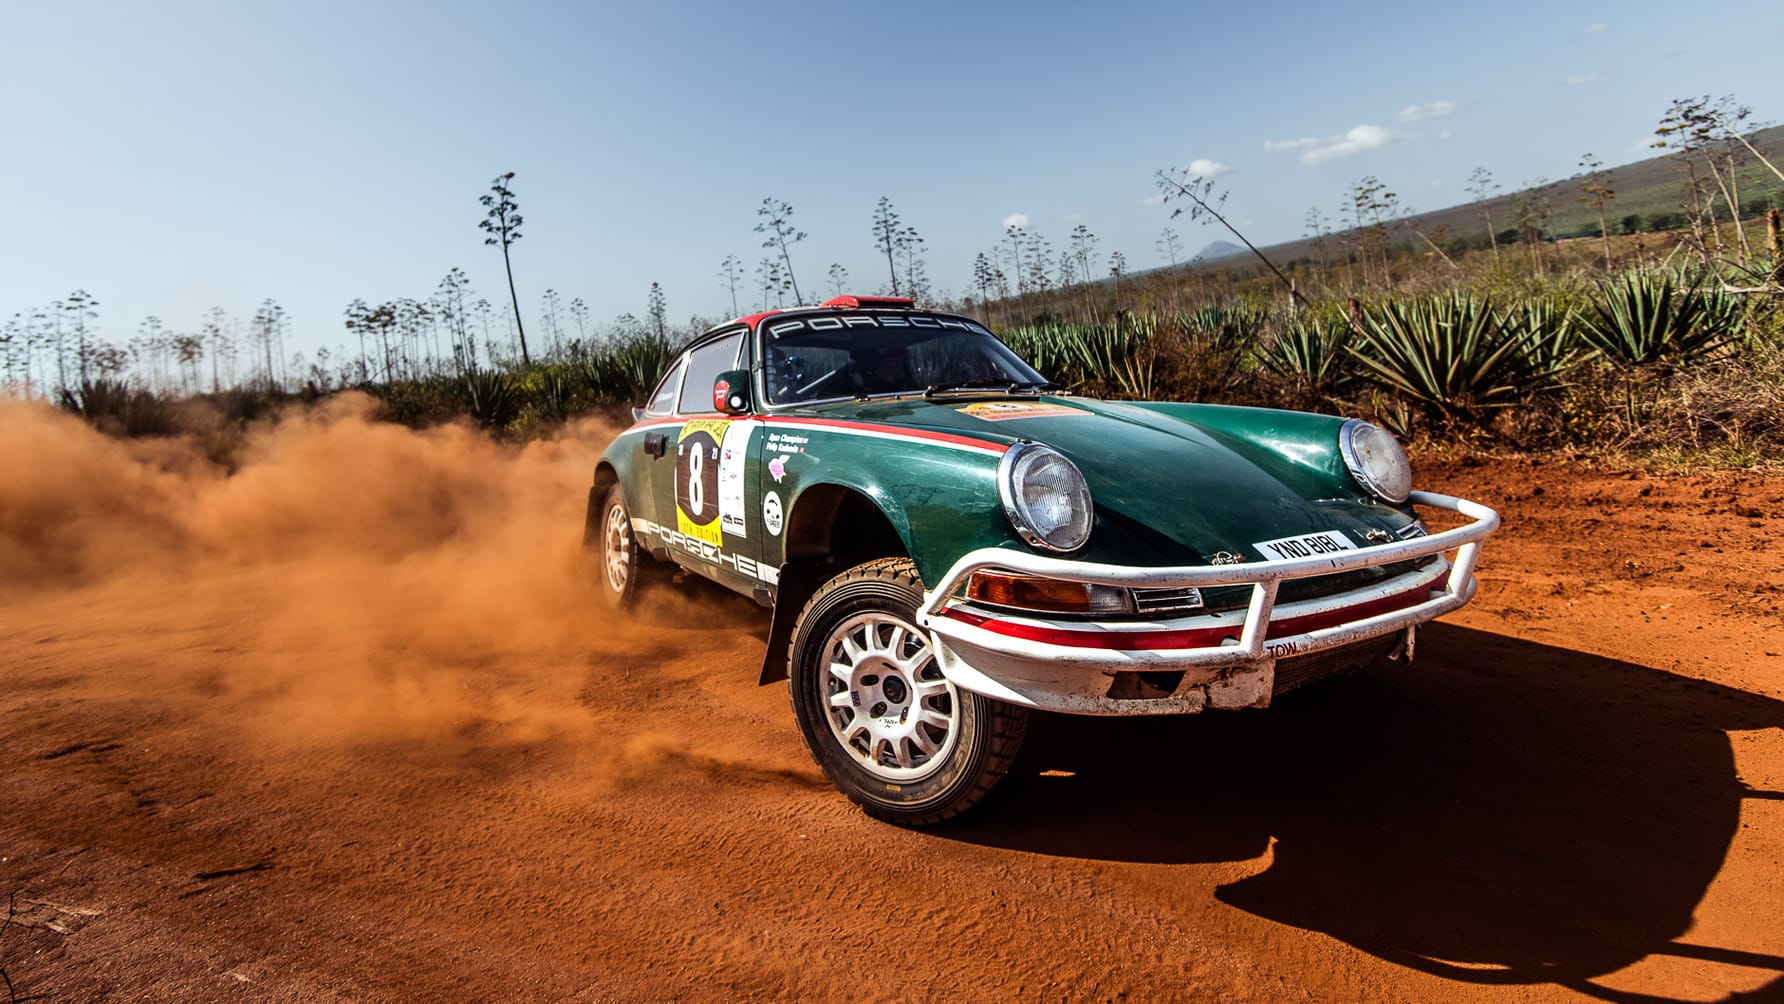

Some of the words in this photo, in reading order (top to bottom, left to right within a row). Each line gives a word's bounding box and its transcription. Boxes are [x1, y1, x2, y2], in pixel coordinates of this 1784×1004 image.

[769, 316, 989, 339] PORSCHE
[688, 441, 703, 516] 8
[696, 526, 719, 545] EDITION
[1266, 540, 1311, 559] YND
[1303, 535, 1348, 554] 818L
[648, 522, 758, 578] PORSCHE
[1267, 641, 1297, 658] TOW
